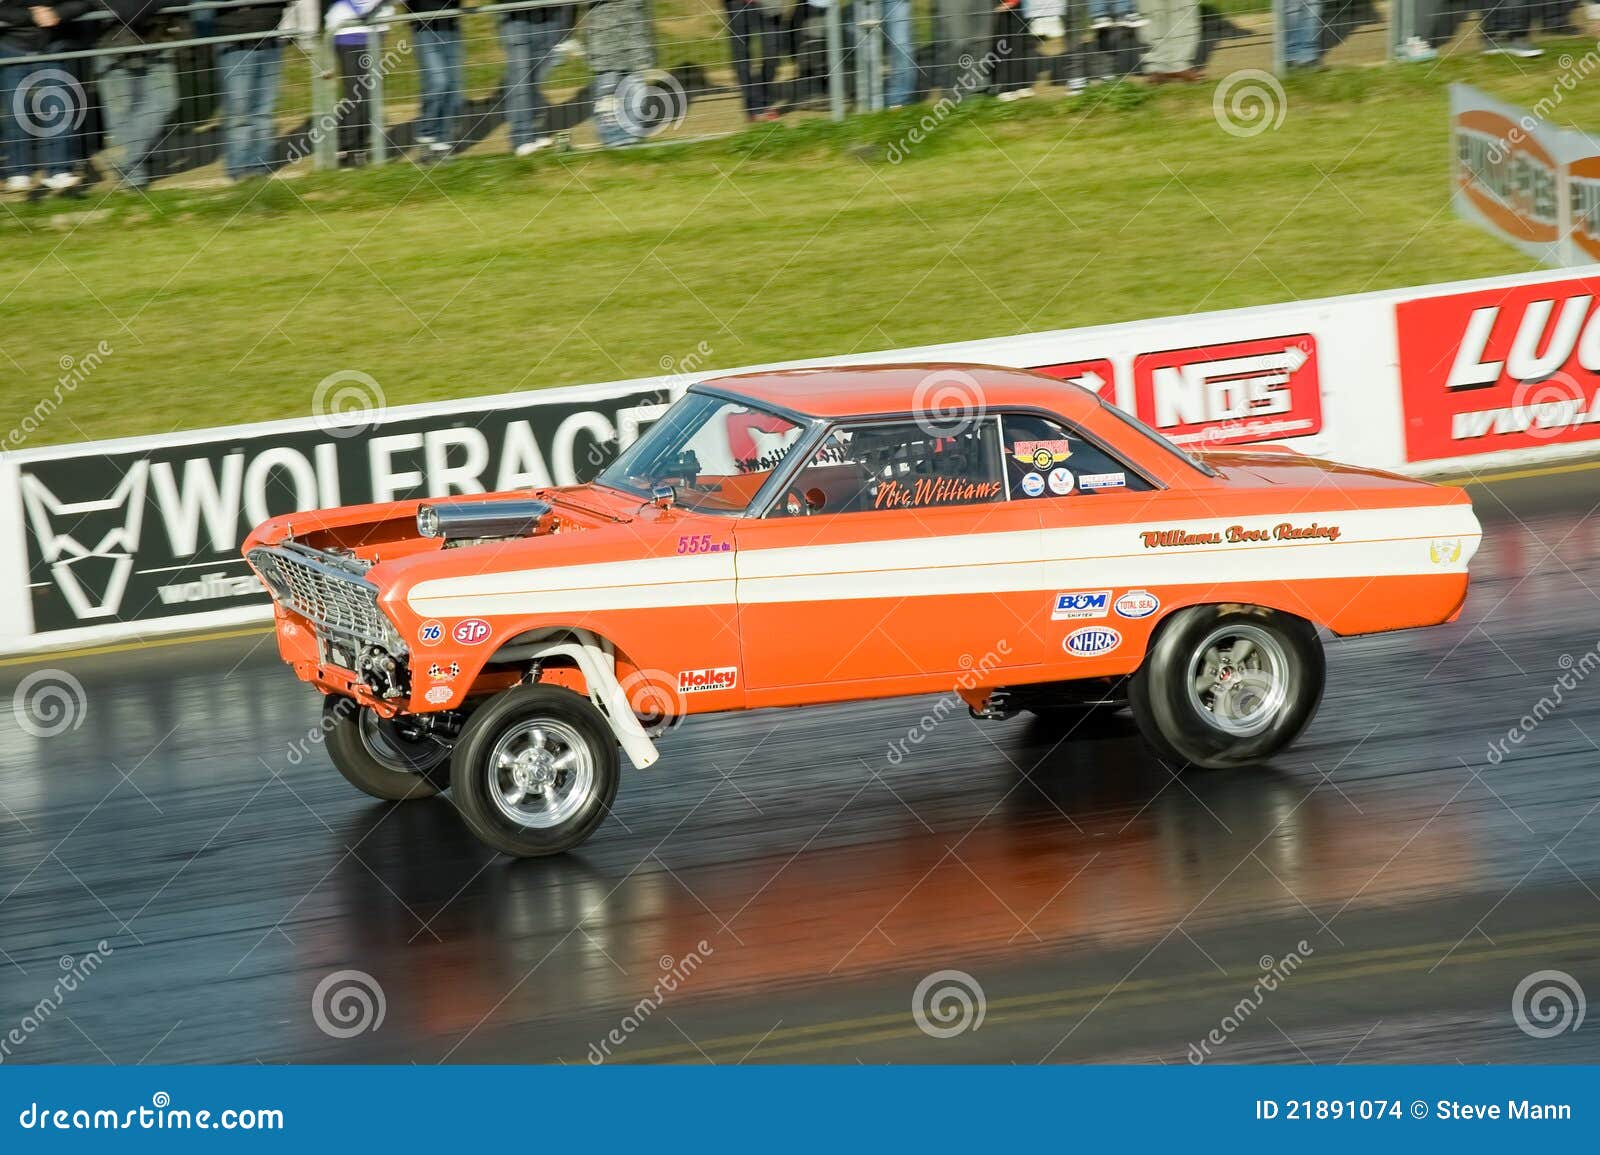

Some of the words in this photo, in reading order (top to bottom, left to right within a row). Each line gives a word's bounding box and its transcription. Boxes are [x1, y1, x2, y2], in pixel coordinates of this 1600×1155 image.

[1152, 363, 1292, 428] NOS
[875, 482, 910, 509] Nic
[915, 477, 1001, 505] Williams
[677, 534, 712, 554] 555
[1140, 529, 1222, 548] Williams
[1225, 525, 1270, 543] Bros
[1273, 523, 1341, 541] Racing
[1058, 594, 1107, 609] B&M
[423, 625, 441, 640] 76
[457, 622, 487, 641] STP
[1073, 632, 1114, 651] NHRA
[680, 669, 736, 688] Holley
